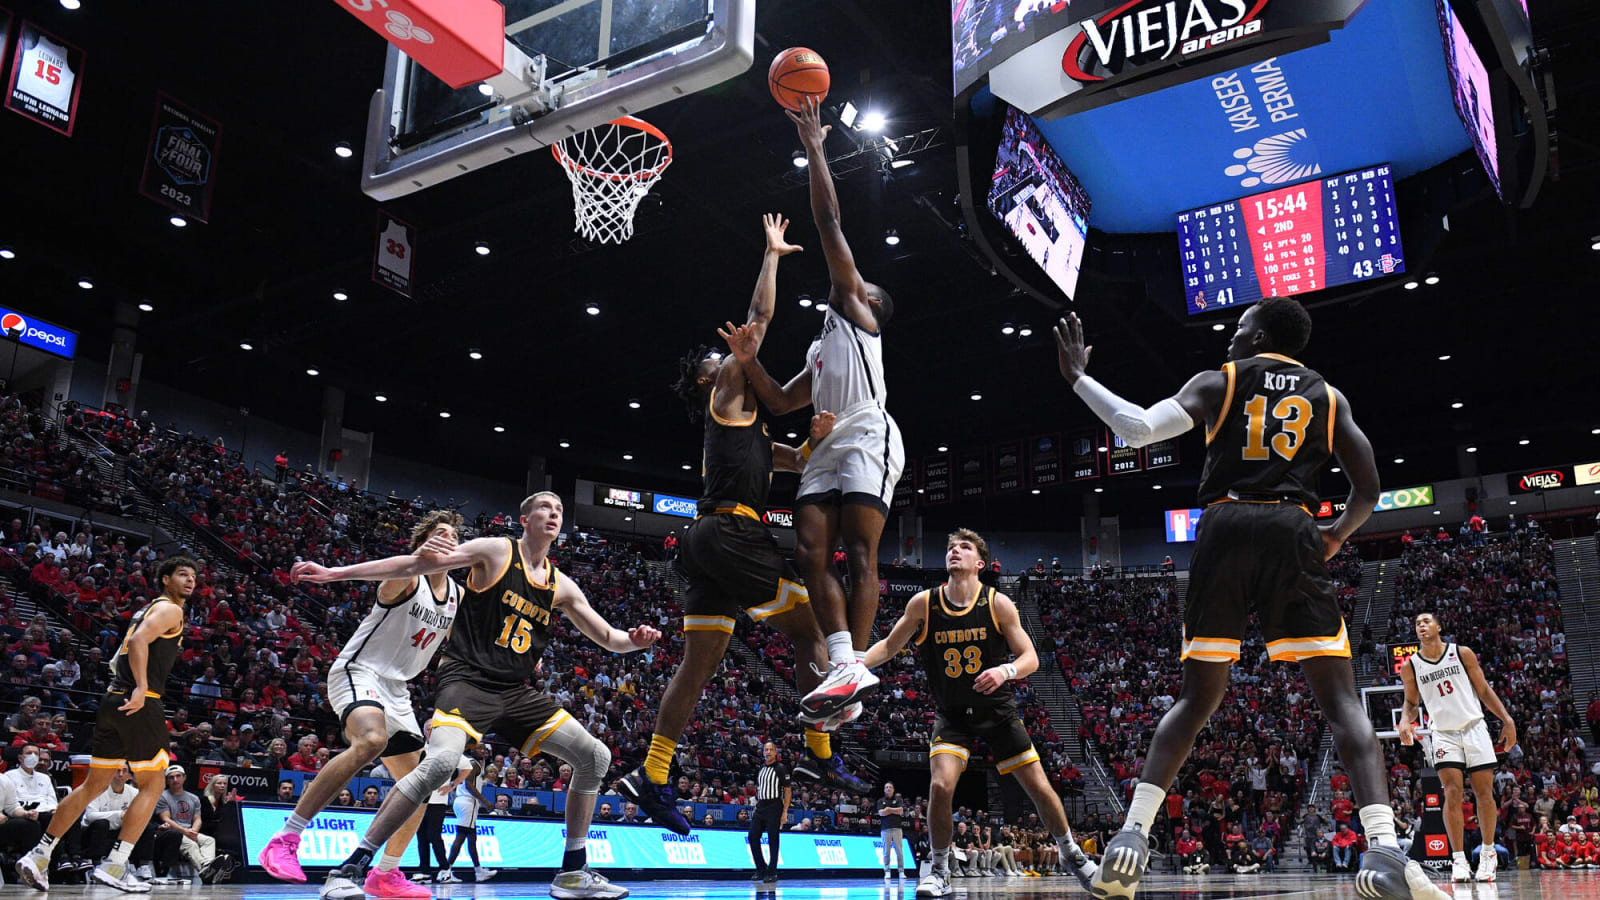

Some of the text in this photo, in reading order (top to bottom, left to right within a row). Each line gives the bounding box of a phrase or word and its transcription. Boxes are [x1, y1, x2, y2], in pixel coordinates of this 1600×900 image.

[1080, 0, 1246, 65] VIEJAS
[1181, 19, 1262, 55] arena
[34, 59, 61, 85] 15
[1251, 57, 1299, 123] PERMA
[13, 90, 69, 122] KAWHI LEONARD
[1212, 72, 1260, 133] KAISER
[168, 135, 202, 161] FINAL
[168, 151, 203, 175] FOUR
[1327, 167, 1389, 188] PLY PTS REB FLS
[160, 184, 192, 206] 2023
[1332, 191, 1338, 200] 3
[1350, 186, 1356, 196] 7
[1367, 182, 1374, 192] 2
[1179, 203, 1235, 223] PLY PTS REB FLS
[1255, 191, 1308, 221] 15:44
[1334, 204, 1340, 214] 5
[1352, 200, 1358, 209] 9
[1369, 196, 1375, 206] 3
[1199, 221, 1205, 231] 2
[1215, 217, 1221, 227] 5
[1228, 215, 1234, 224] 3
[1273, 220, 1294, 234] 2ND
[1334, 217, 1345, 228] 13
[1352, 213, 1363, 224] 10
[1371, 210, 1377, 220] 3
[1185, 228, 1236, 247] 3 16 3 0
[1263, 241, 1273, 251] 54
[1301, 233, 1312, 243] 20
[1337, 231, 1347, 242] 14
[1356, 228, 1362, 237] 6
[1373, 224, 1380, 233] 0
[386, 238, 406, 260] 33
[1185, 250, 1195, 261] 13
[1201, 247, 1211, 257] 11
[1218, 244, 1224, 253] 2
[1264, 253, 1275, 263] 48
[1303, 244, 1313, 254] 40
[1338, 235, 1396, 255] 40 0 0 3
[1187, 263, 1197, 274] 15
[1204, 261, 1210, 270] 0
[1233, 255, 1240, 264] 0
[1264, 264, 1279, 275] 100
[1282, 262, 1290, 270] FT
[1304, 256, 1315, 266] 83
[1353, 260, 1373, 278] 43
[1188, 268, 1241, 287] 33 10 3 2
[1270, 269, 1314, 286] 5 FOULS 3
[1310, 280, 1316, 289] 3
[1217, 287, 1234, 305] 41
[27, 328, 66, 347] pepsi
[1264, 371, 1300, 391] KOT
[1242, 394, 1314, 462] 13
[1114, 461, 1135, 471] 2012
[1153, 456, 1172, 465] 2013
[1075, 469, 1092, 478] 2012
[1522, 473, 1558, 488] VIEJAS
[626, 501, 645, 510] Diego
[1378, 487, 1430, 510] COX
[890, 583, 924, 592] TOYOTA
[409, 602, 424, 619] SAN
[502, 589, 551, 626] COWBOYS
[411, 627, 437, 650] 40
[495, 613, 533, 655] 15
[935, 627, 987, 644] COWBOYS
[1393, 645, 1418, 657] 15:44
[944, 646, 982, 678] 33
[1419, 665, 1460, 685] SAN DIEGO STATE
[1436, 680, 1454, 697] 13
[226, 774, 269, 787] TOYOTA
[316, 818, 356, 831] LIGHT
[588, 829, 608, 840] IGHT
[661, 833, 700, 843] BUD LIGHT
[814, 838, 828, 847] BUD
[297, 830, 359, 861] ELTZER
[663, 842, 707, 865] SELTZER
